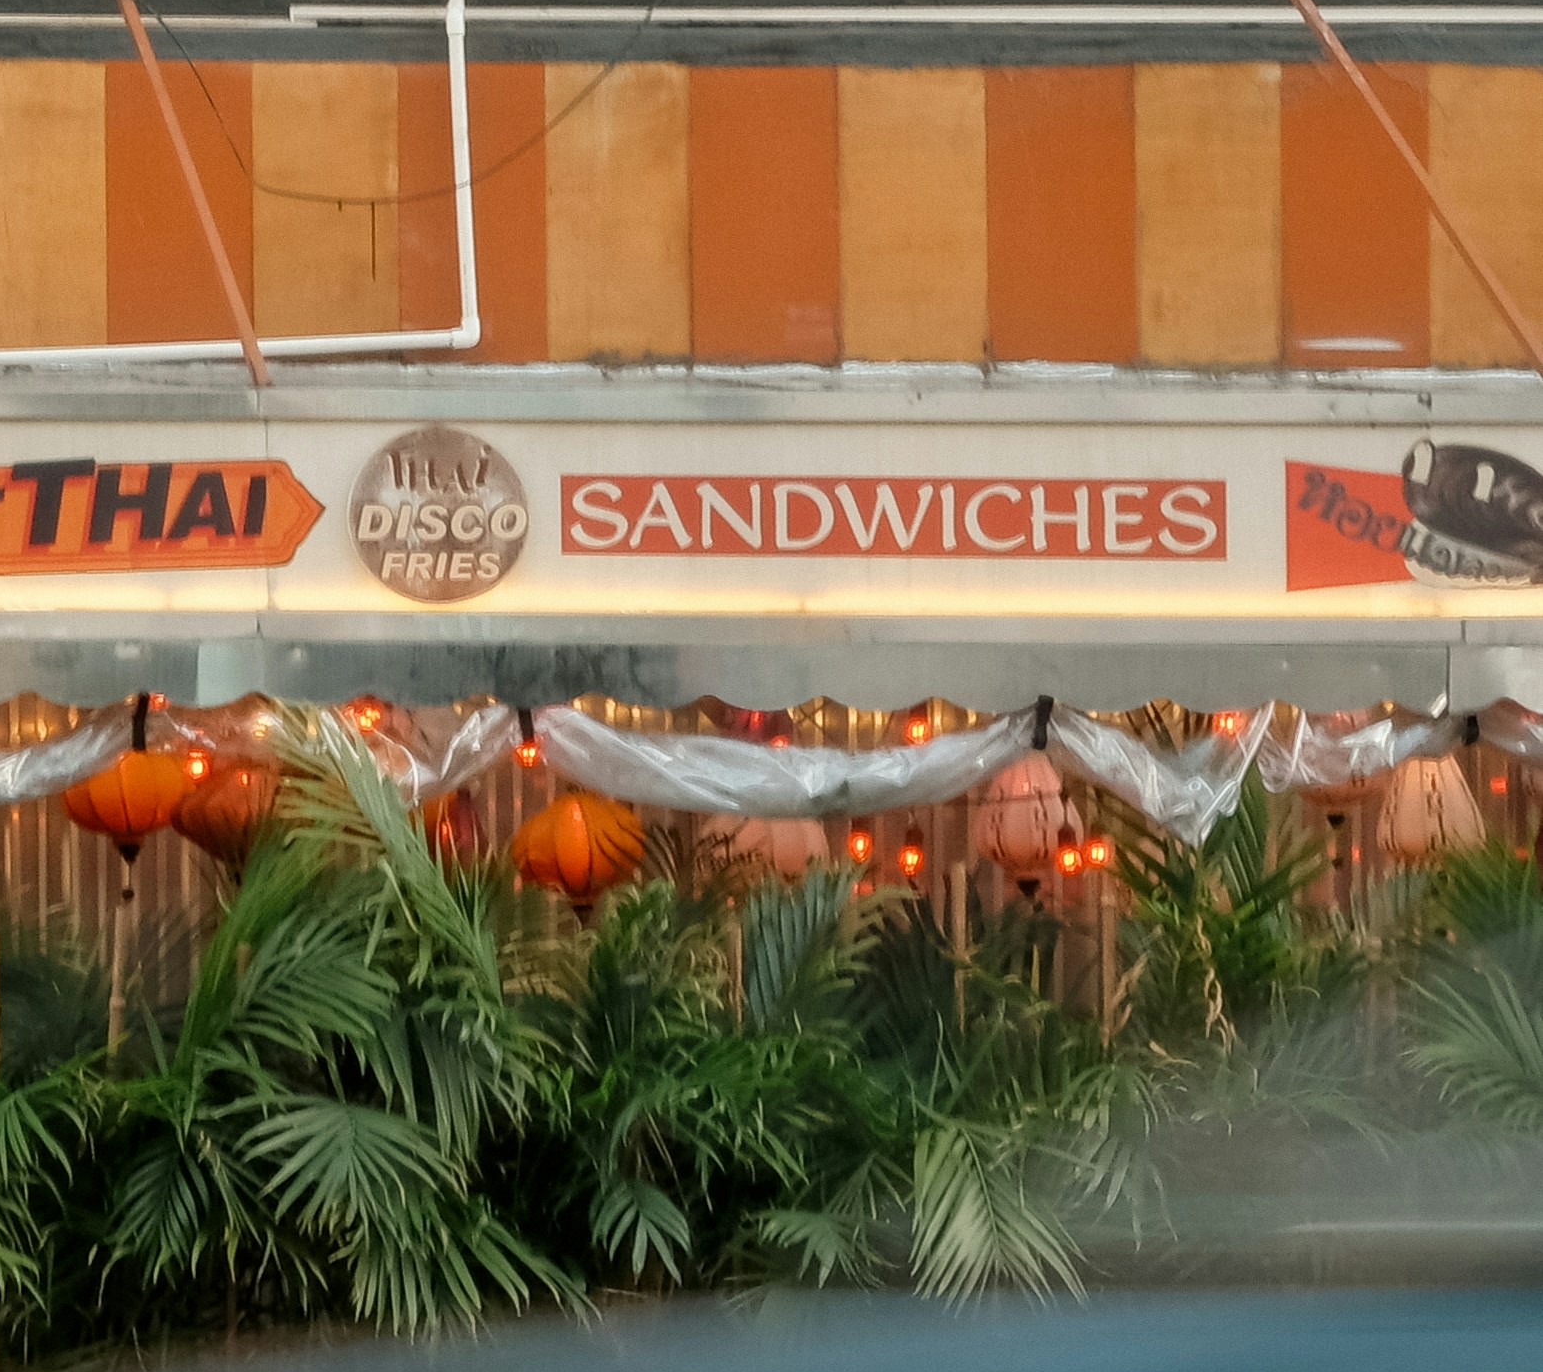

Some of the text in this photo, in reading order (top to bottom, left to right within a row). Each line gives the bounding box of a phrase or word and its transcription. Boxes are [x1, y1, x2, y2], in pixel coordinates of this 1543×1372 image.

[13, 458, 267, 547] THAI
[357, 503, 529, 543] DISCO
[569, 481, 1219, 556] SANDWICHES
[381, 551, 502, 581] FRIES
